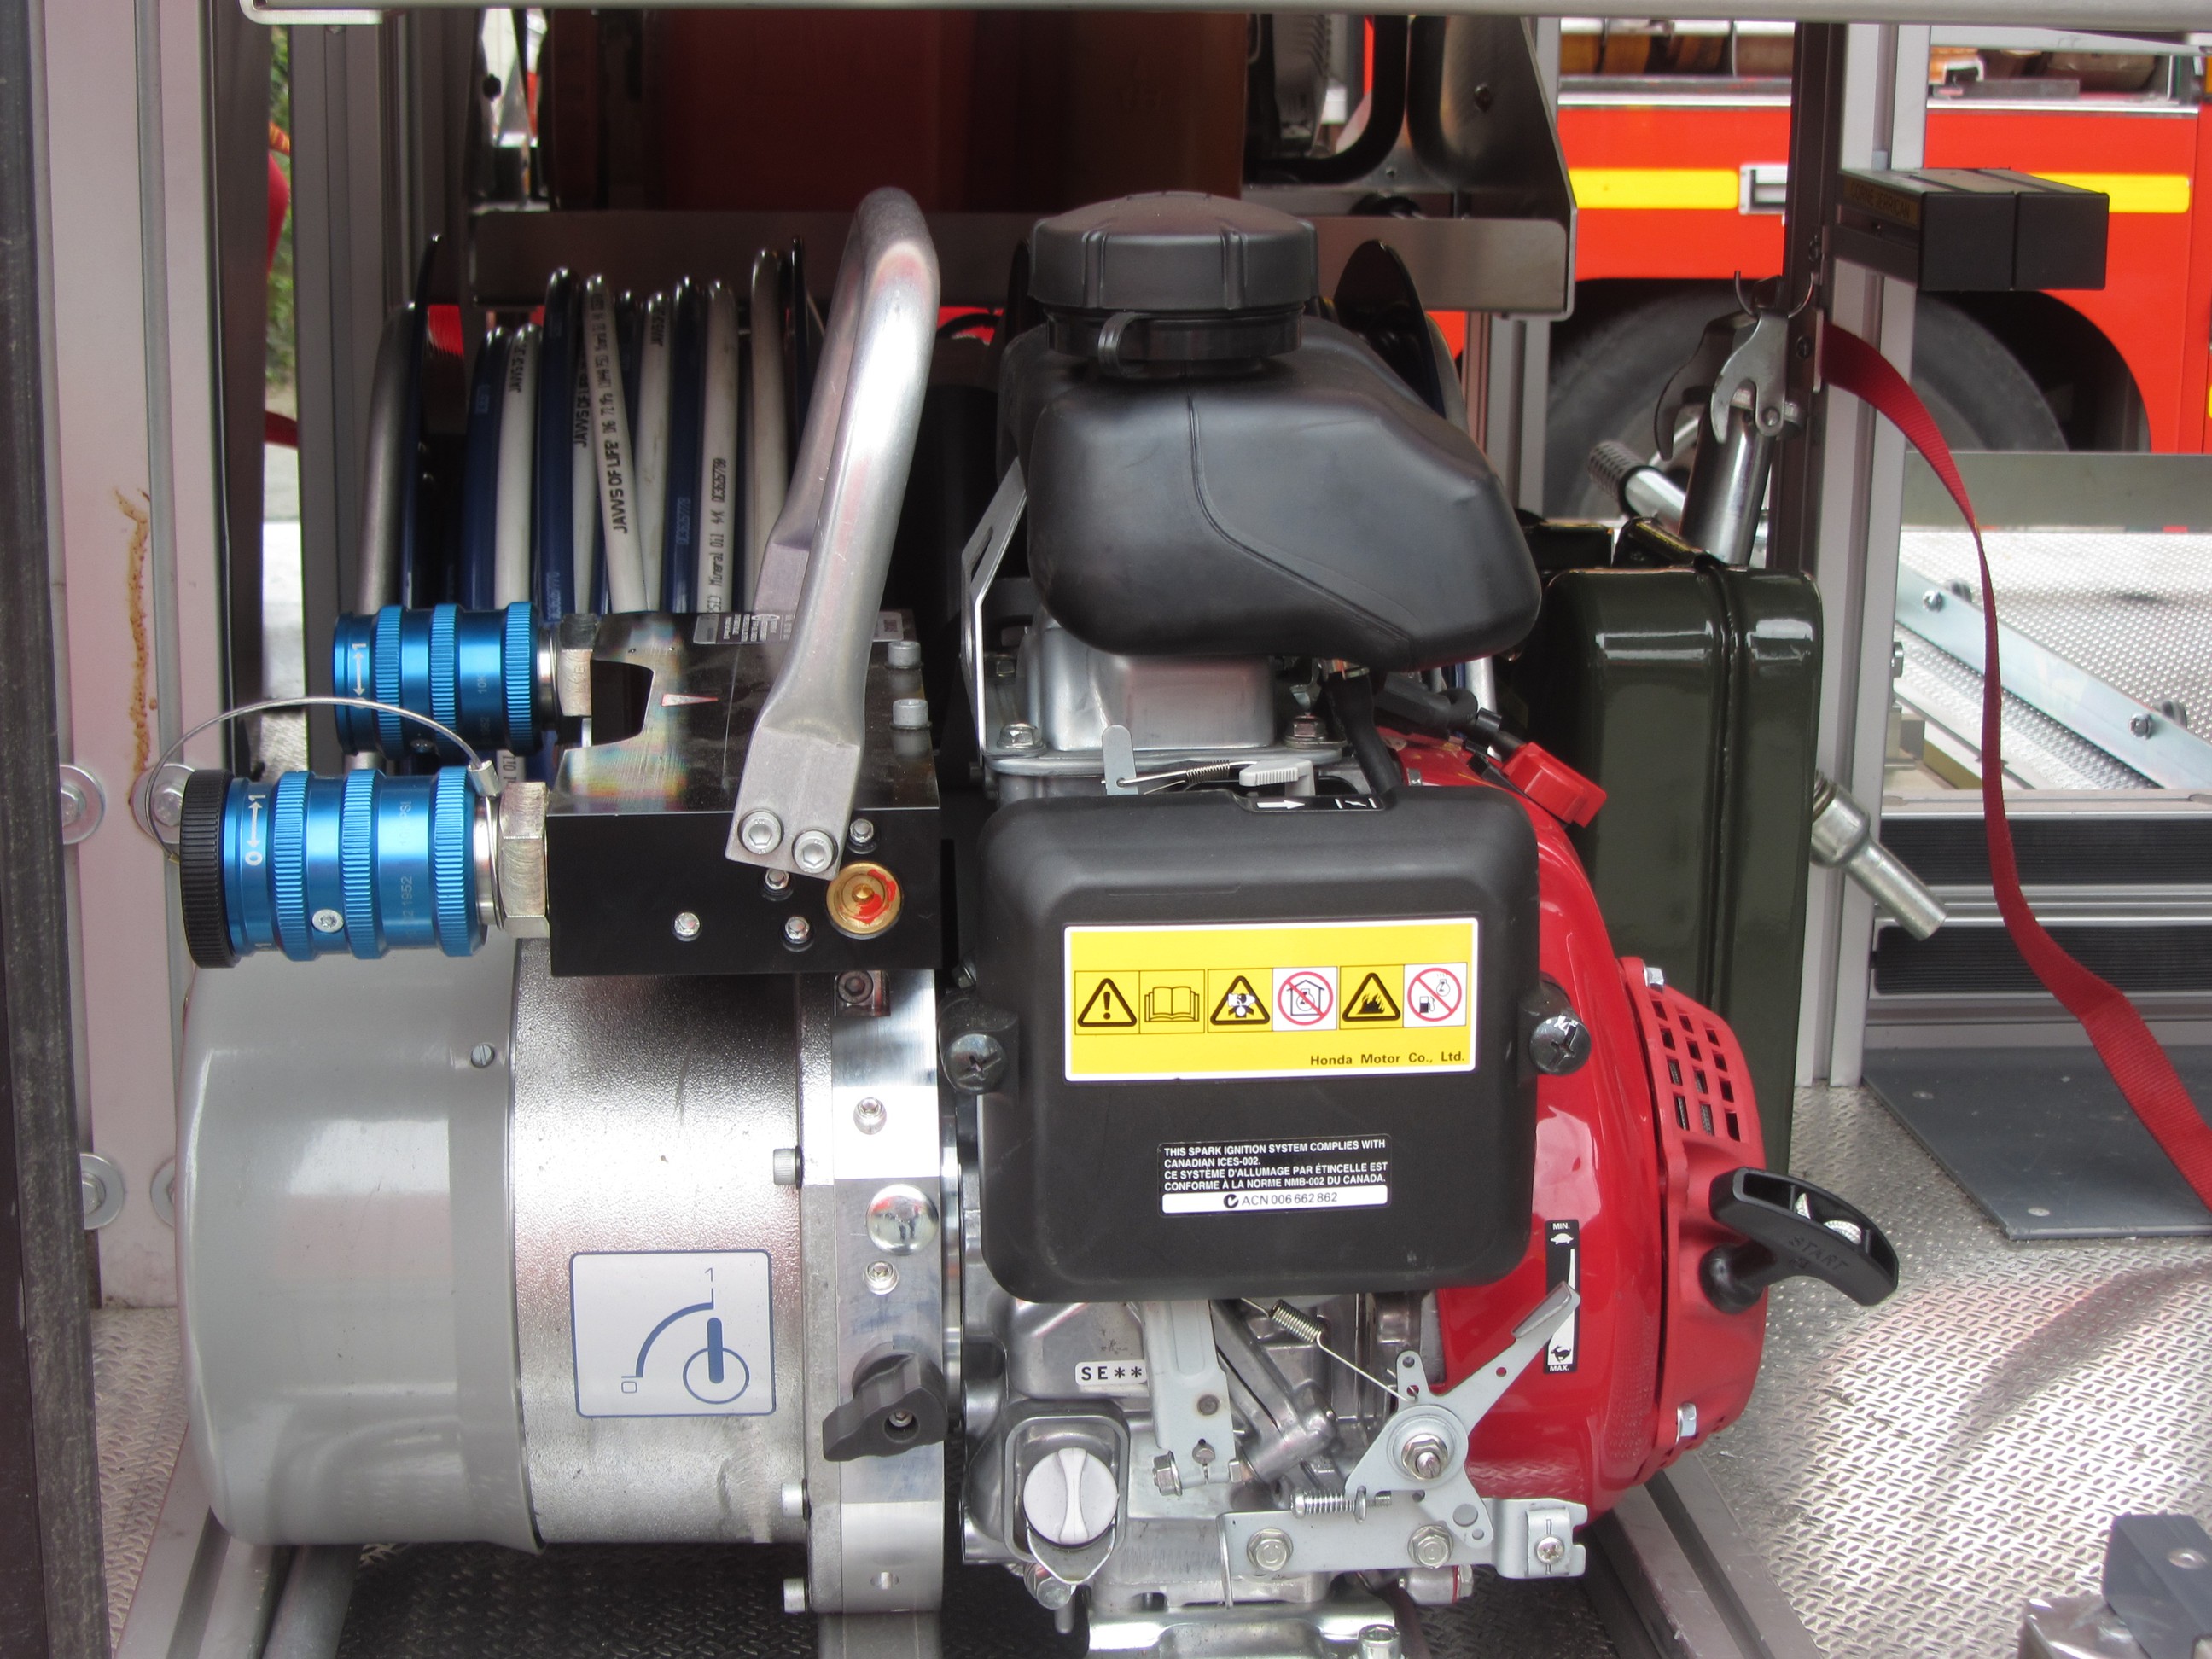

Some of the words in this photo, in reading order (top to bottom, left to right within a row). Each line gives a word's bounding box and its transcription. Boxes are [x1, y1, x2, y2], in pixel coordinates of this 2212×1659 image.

[573, 410, 589, 448] JAWS
[608, 470, 622, 486] OF
[610, 488, 628, 534] JAWS
[710, 533, 724, 548] Oil
[708, 552, 724, 586] Mineral
[401, 876, 413, 905] 1952
[1310, 1054, 1353, 1066] Honda
[1360, 1053, 1400, 1064] Motor
[1408, 1052, 1433, 1063] Co.,
[1441, 1051, 1464, 1062] Ltd.
[1164, 1147, 1186, 1156] THIS
[1188, 1146, 1222, 1156] SPARK
[1224, 1144, 1266, 1155] IGNITION
[1269, 1143, 1307, 1153] SYSTEM
[1310, 1140, 1359, 1151] COMPLIES
[1361, 1139, 1386, 1149] WITH
[1164, 1158, 1215, 1168] CANADIAN
[1217, 1156, 1261, 1167] ICES-002.
[1164, 1170, 1178, 1180] CE
[1180, 1167, 1225, 1179] SYSTÈME
[1228, 1166, 1290, 1178] D'ALLUMAGE
[1293, 1165, 1313, 1175] PAR
[1315, 1163, 1367, 1174] ÉTINCELLE
[1370, 1161, 1388, 1172] EST
[1164, 1180, 1220, 1191] CONFORME
[1222, 1179, 1229, 1190] À
[1231, 1179, 1244, 1189] LA
[1247, 1178, 1282, 1188] NORME
[1284, 1177, 1324, 1187] NMB-002
[1327, 1175, 1341, 1185] DU
[1342, 1173, 1386, 1185] CANADA.
[1242, 1195, 1268, 1206] ACN
[1271, 1194, 1292, 1205] 006
[1294, 1193, 1314, 1203] 662
[1317, 1191, 1337, 1202] 862
[1788, 1235, 1849, 1270] START
[704, 1267, 713, 1282] 1
